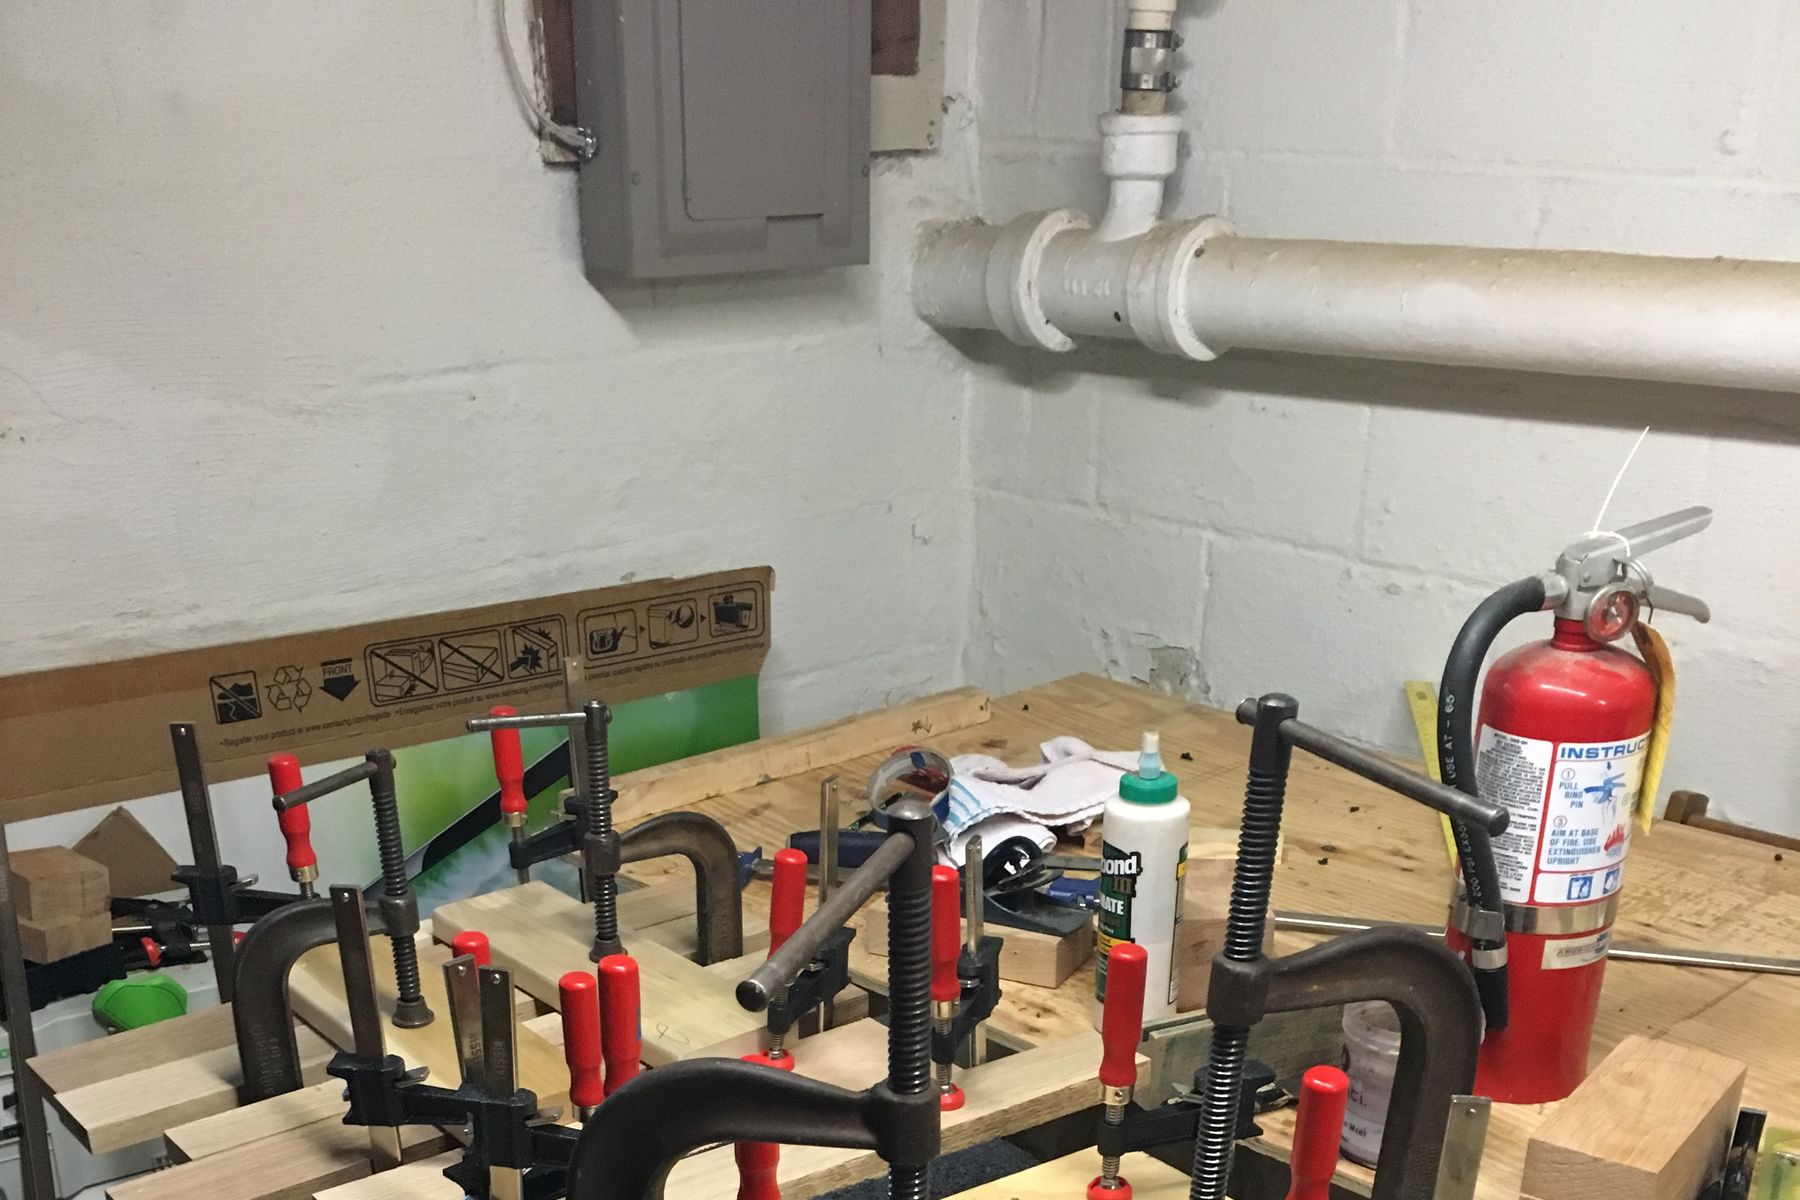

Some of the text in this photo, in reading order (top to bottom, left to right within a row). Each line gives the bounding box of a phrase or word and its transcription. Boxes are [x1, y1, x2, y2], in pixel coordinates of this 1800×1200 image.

[323, 664, 353, 677] FRONT
[1444, 734, 1453, 750] AT
[1445, 756, 1457, 779] USE
[1559, 782, 1579, 790] PULL
[1570, 800, 1584, 808] PIN
[1551, 829, 1566, 837] AIM
[1581, 828, 1600, 836] BASE
[1550, 838, 1561, 846] OF
[1583, 837, 1597, 845] USE
[1547, 857, 1580, 865] UPRIGHT
